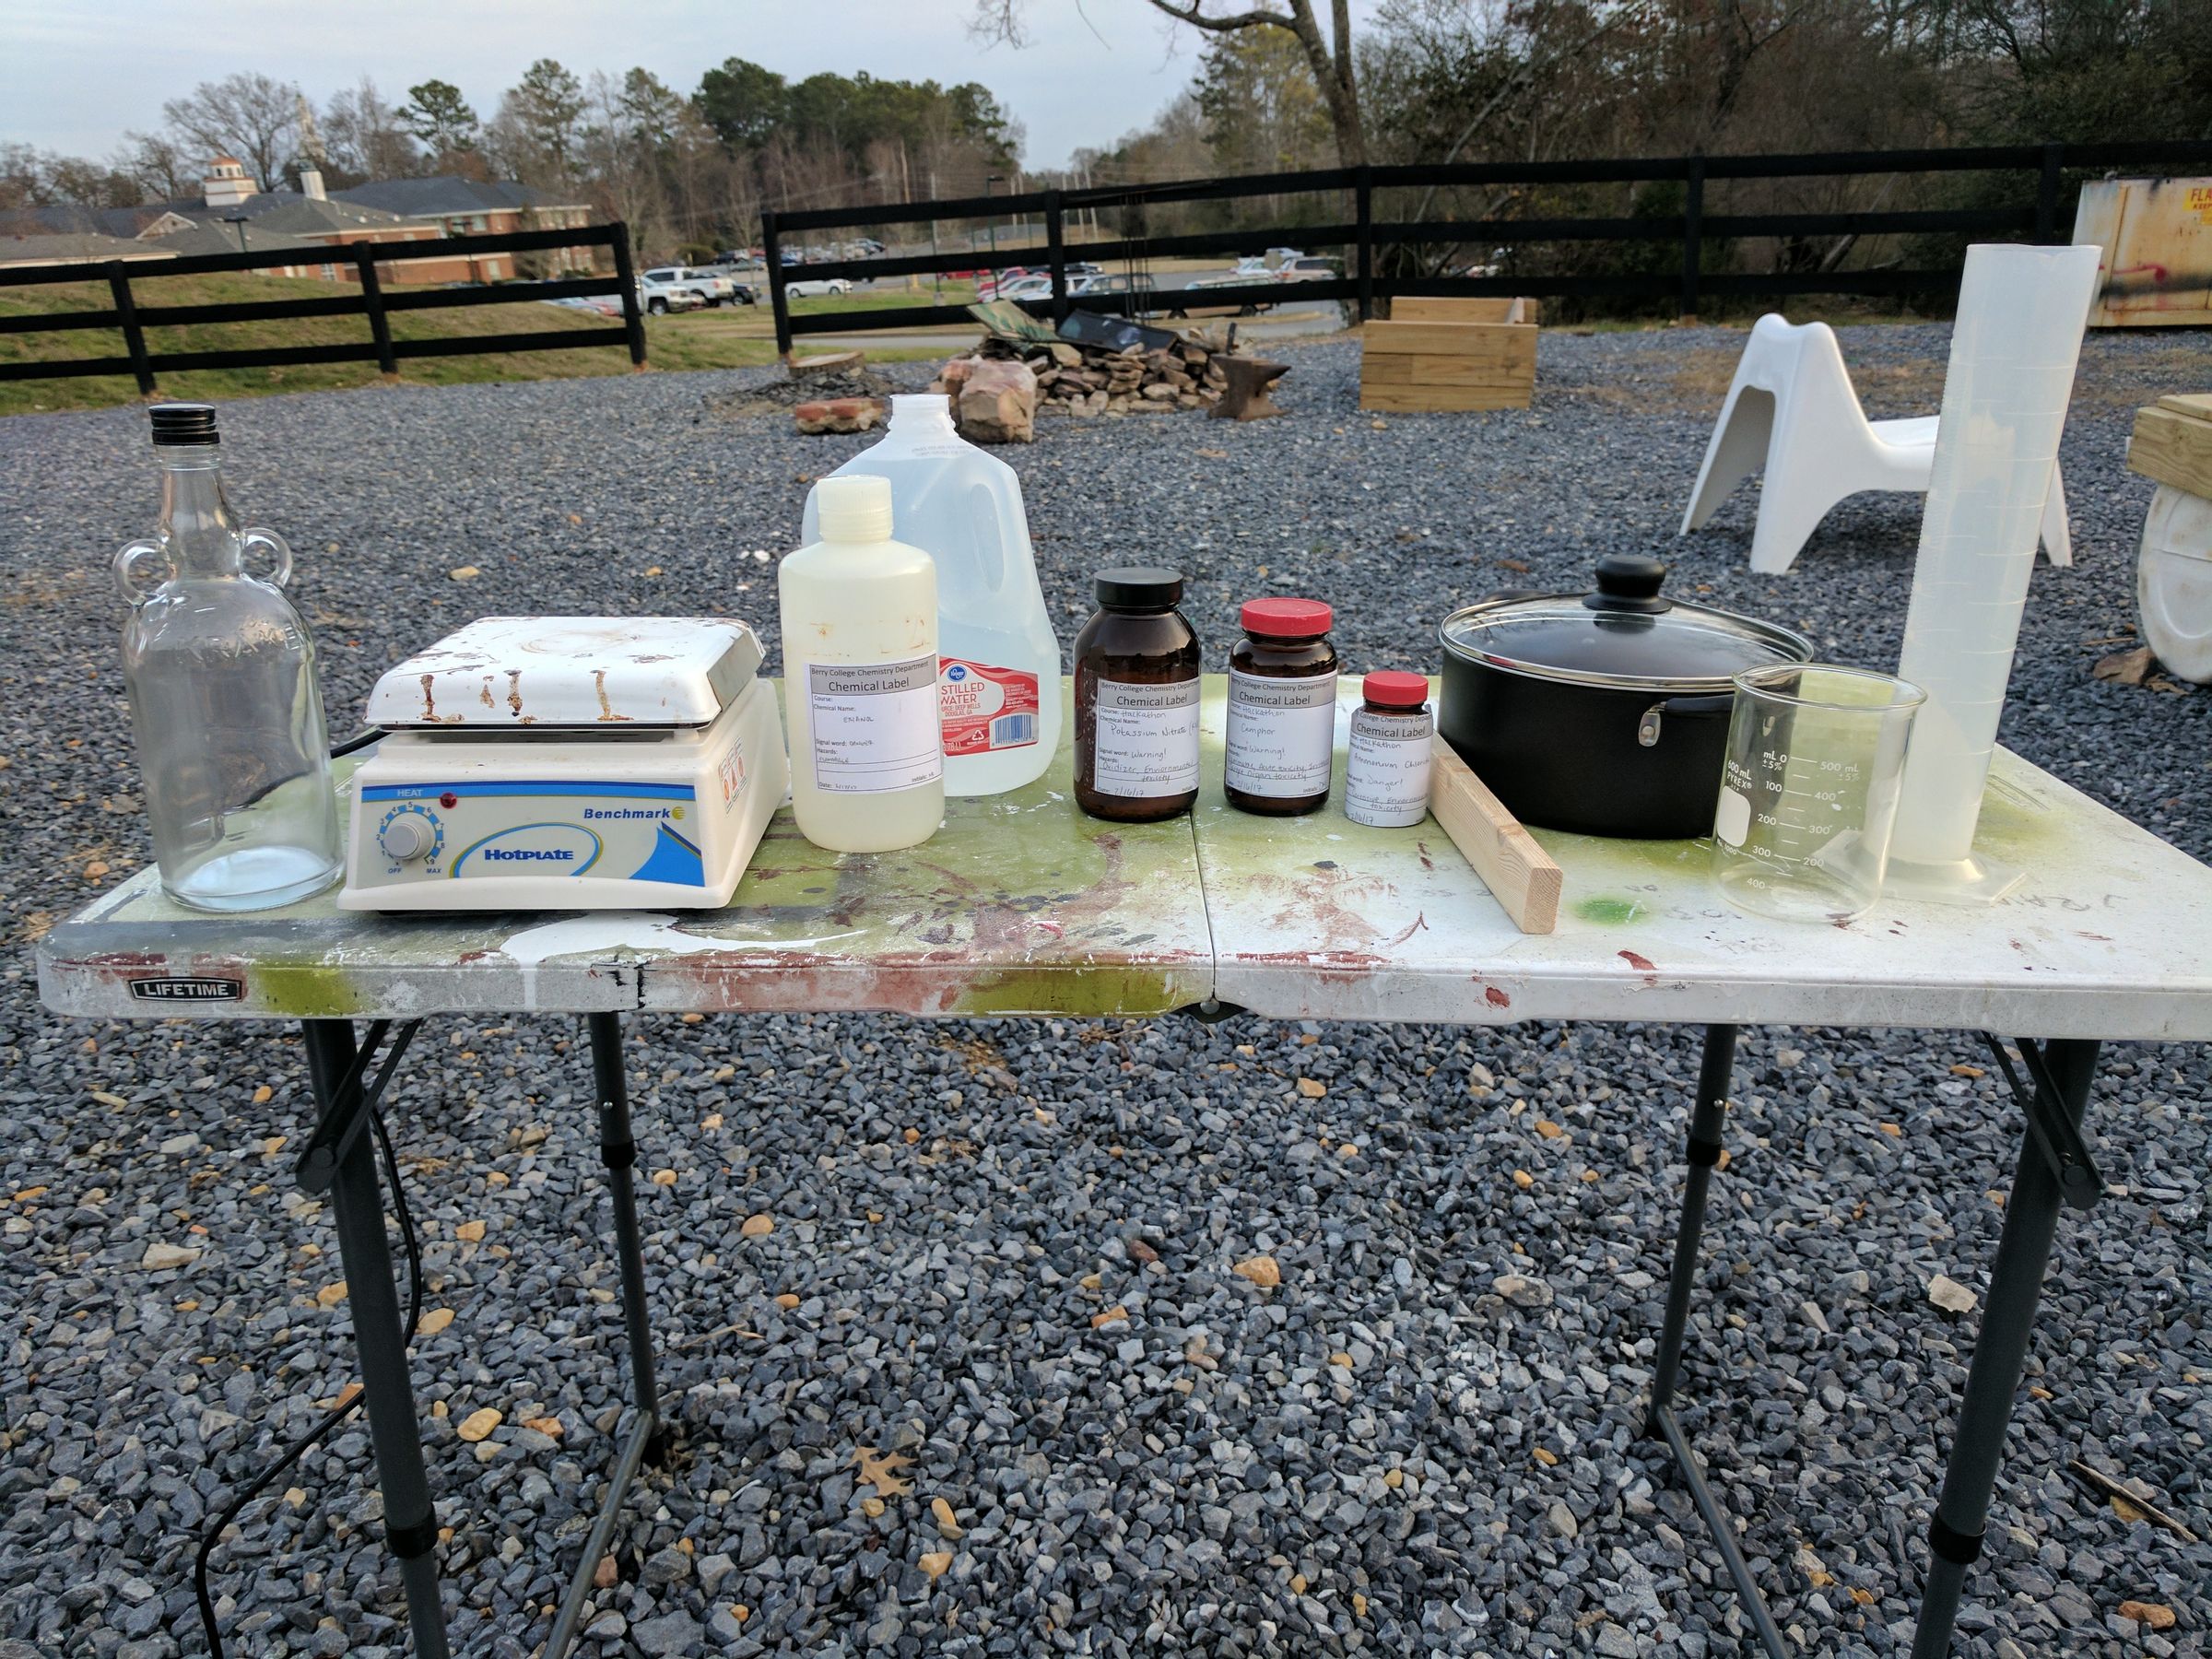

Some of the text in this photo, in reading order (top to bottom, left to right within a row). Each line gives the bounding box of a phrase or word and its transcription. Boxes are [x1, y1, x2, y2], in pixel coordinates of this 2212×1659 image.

[811, 660, 929, 678] Berry College Chemistry Department
[829, 677, 910, 692] Chemical Label
[941, 682, 985, 695] STILLED
[1101, 683, 1117, 691] Berry
[1118, 684, 1144, 693] College
[1145, 684, 1176, 693] Chemistry
[1241, 679, 1262, 690] College
[1262, 683, 1297, 692] Chemistry
[1297, 680, 1331, 691] Department
[1116, 693, 1188, 707] Chemical Label
[1239, 690, 1311, 706] Chemical Label
[813, 703, 837, 712] Chemical
[1380, 716, 1414, 724] Chemistry
[1107, 721, 1158, 736] Potassium
[1161, 726, 1187, 736] Nitrate
[1356, 722, 1426, 737] Chemical Label
[1131, 747, 1167, 761] Warning!
[1763, 749, 1788, 763] mL 0
[1727, 759, 1752, 781] 600 mL
[1819, 761, 1860, 772] 500 mL
[1367, 774, 1404, 792] Danger!
[1765, 781, 1783, 793] 100
[397, 788, 424, 797] HEAT
[1813, 791, 1836, 802] 400
[583, 807, 671, 819] Benchmark
[1757, 813, 1777, 826] 200
[1807, 825, 1830, 835] 300
[1751, 844, 1771, 857] 300
[1803, 856, 1825, 867] 200
[1747, 877, 1766, 889] 400
[144, 983, 229, 996] LIFETIME
